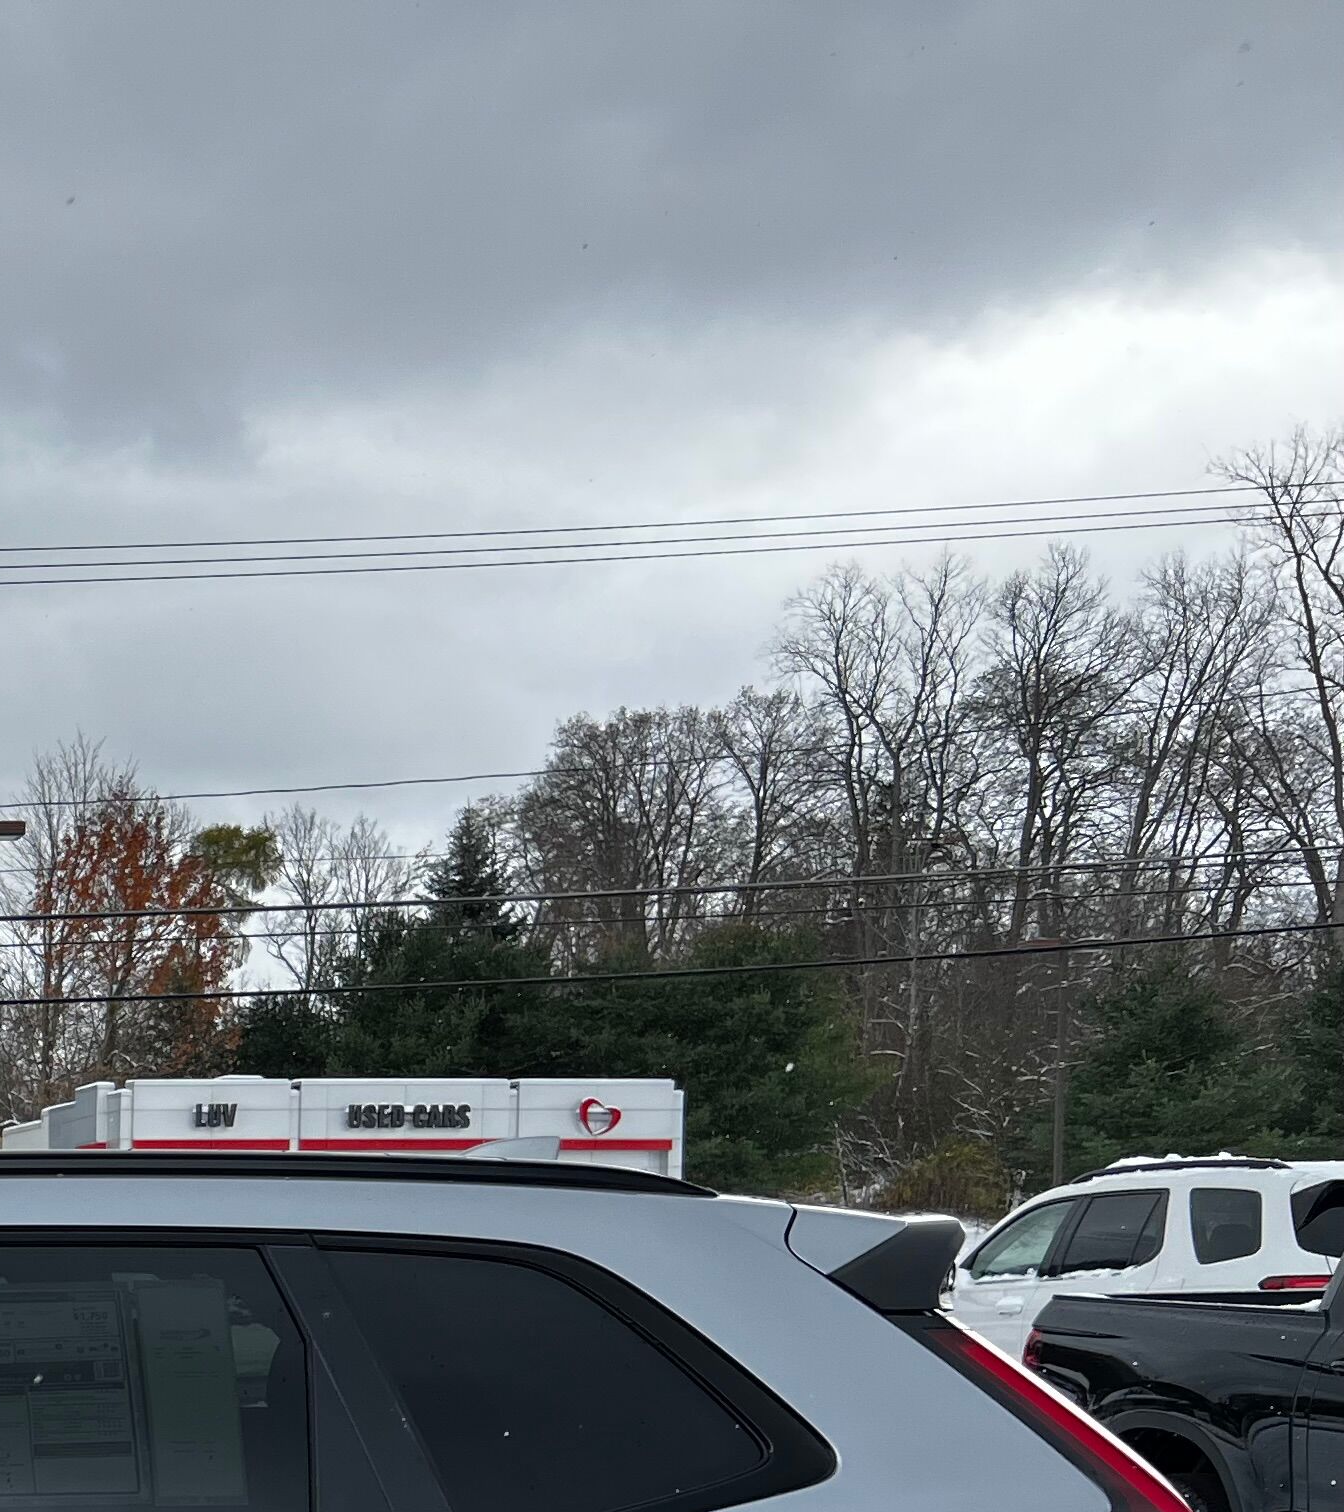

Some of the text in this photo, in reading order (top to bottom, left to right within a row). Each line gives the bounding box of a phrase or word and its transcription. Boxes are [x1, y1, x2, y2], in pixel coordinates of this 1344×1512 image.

[194, 1103, 238, 1128] LUV
[347, 1103, 472, 1129] USED CARS
